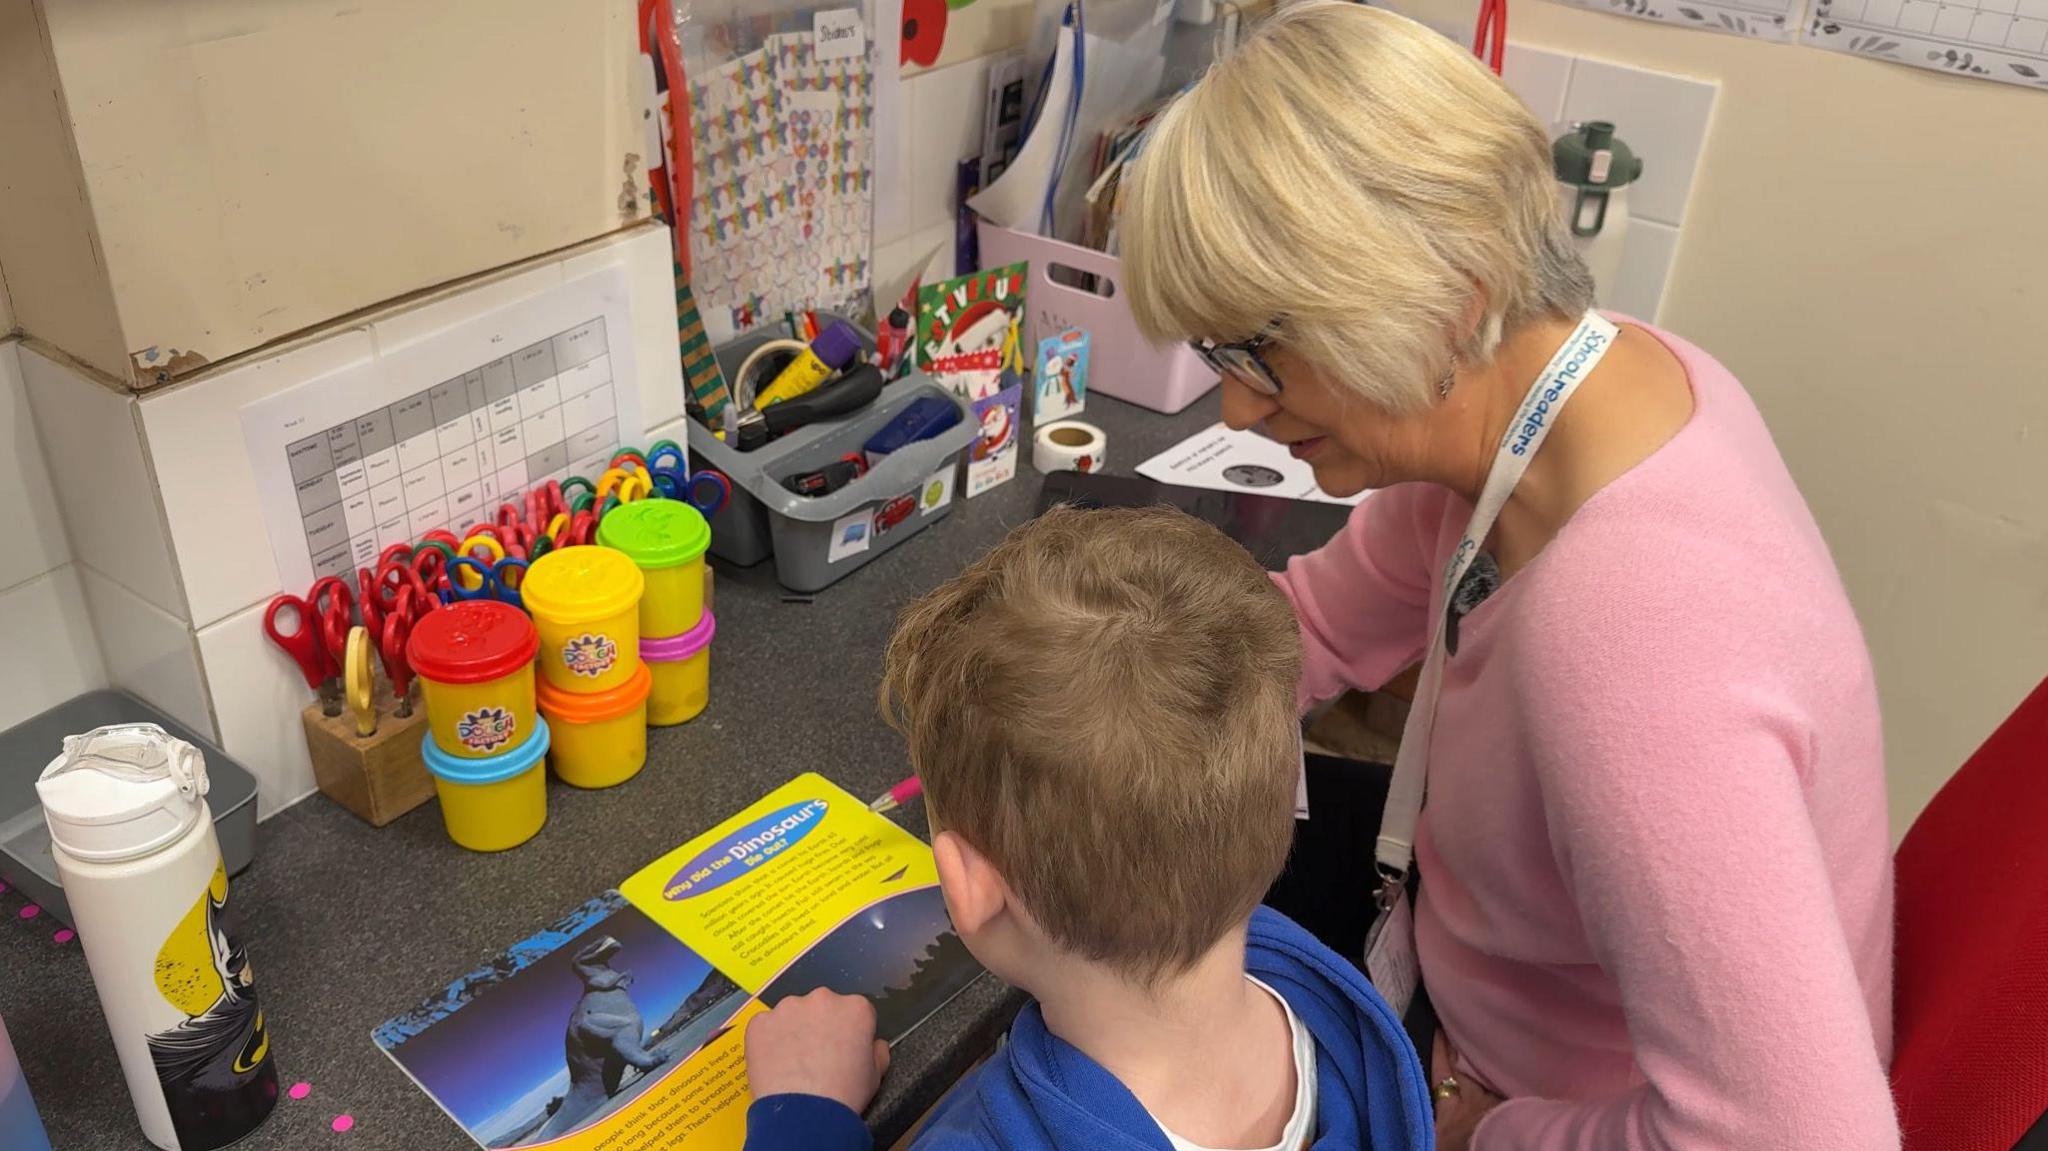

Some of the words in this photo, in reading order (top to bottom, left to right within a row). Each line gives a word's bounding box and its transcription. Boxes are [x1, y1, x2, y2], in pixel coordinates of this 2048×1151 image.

[664, 883, 692, 899] Why
[690, 867, 711, 882] Did
[710, 854, 731, 870] the
[728, 799, 829, 860] Dinosaurs
[594, 1129, 624, 1151] people
[625, 1112, 646, 1128] think
[648, 1096, 669, 1111] that
[670, 1067, 709, 1096] dinosaurs
[708, 1051, 729, 1066] lived
[623, 1130, 646, 1146] long
[644, 1104, 680, 1130] because
[682, 1086, 704, 1103] some
[703, 1070, 726, 1086] kinds
[666, 1114, 688, 1131] them
[688, 1105, 700, 1114] to
[700, 1081, 733, 1105] breathe
[666, 1133, 688, 1147] legs.
[686, 1113, 712, 1132] These
[712, 1091, 741, 1112] helped
